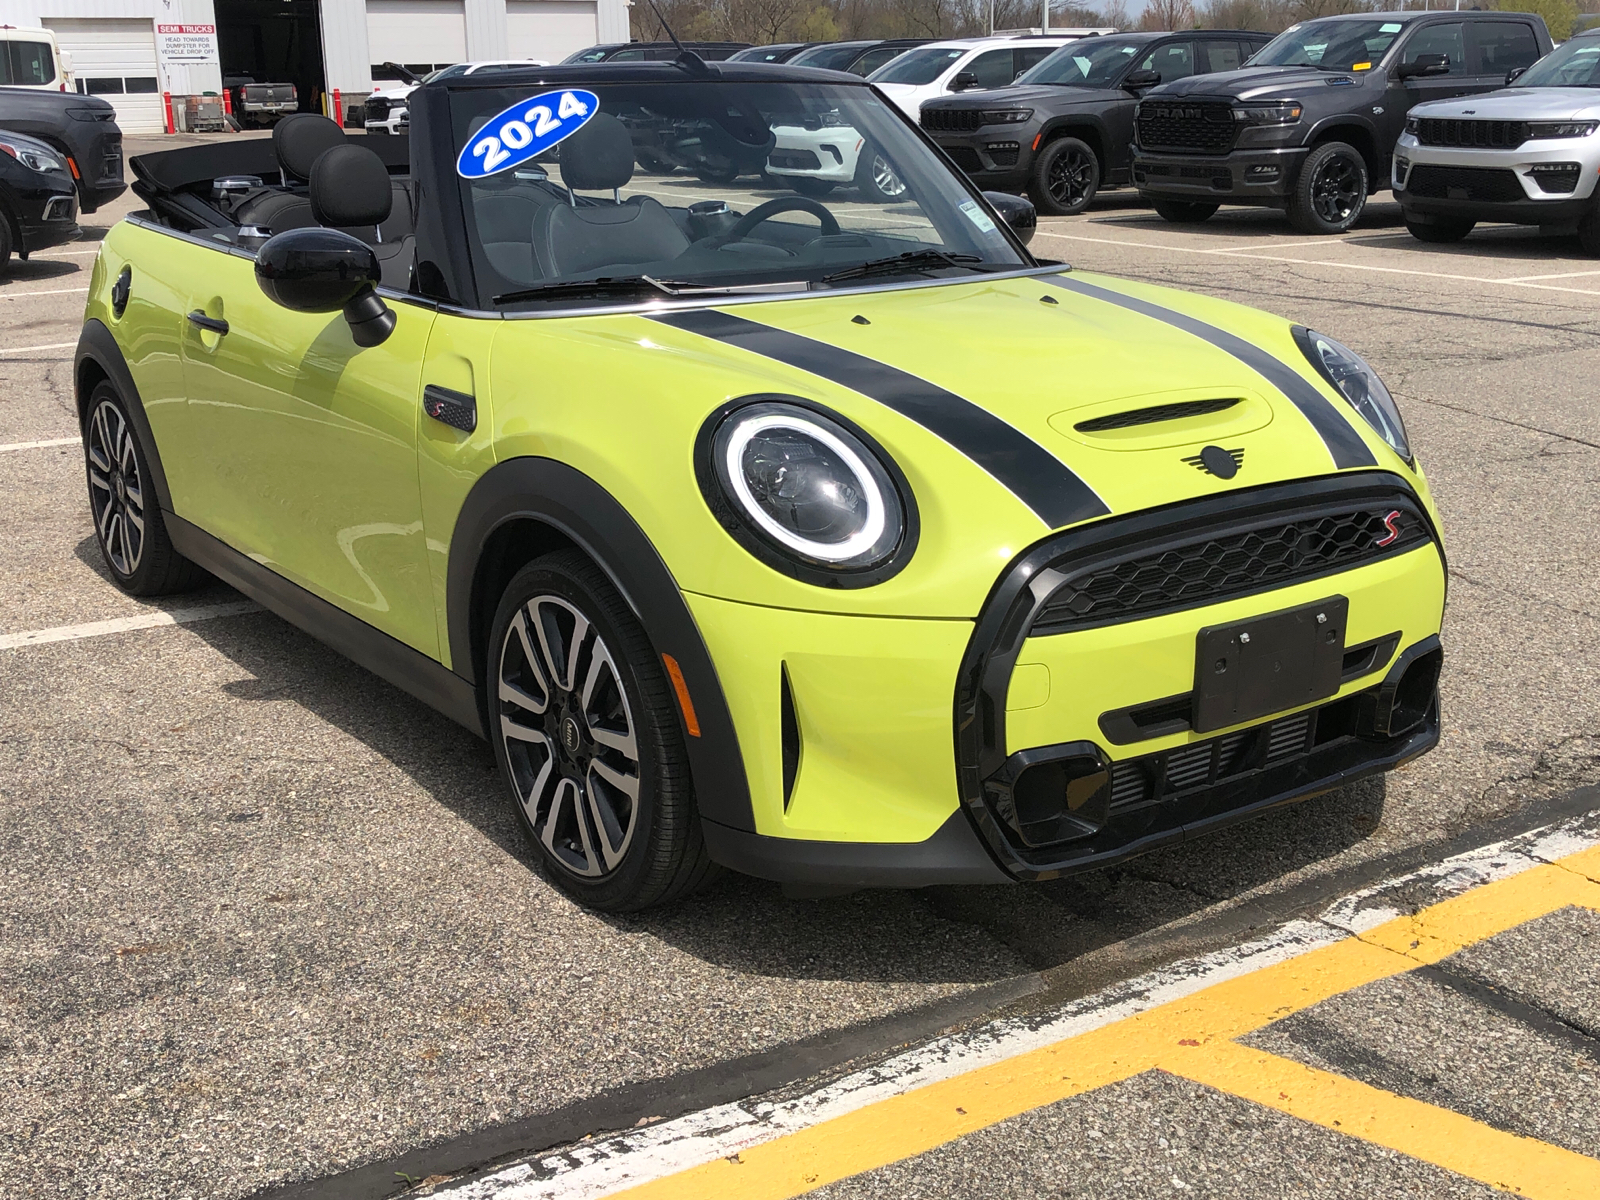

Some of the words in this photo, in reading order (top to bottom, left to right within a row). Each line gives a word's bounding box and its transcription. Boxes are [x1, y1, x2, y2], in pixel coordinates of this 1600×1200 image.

[160, 25, 180, 33] SEMI
[181, 25, 213, 33] TRUCKS
[1156, 108, 1202, 118] RAM
[473, 91, 588, 173] 2024
[1375, 510, 1401, 547] S
